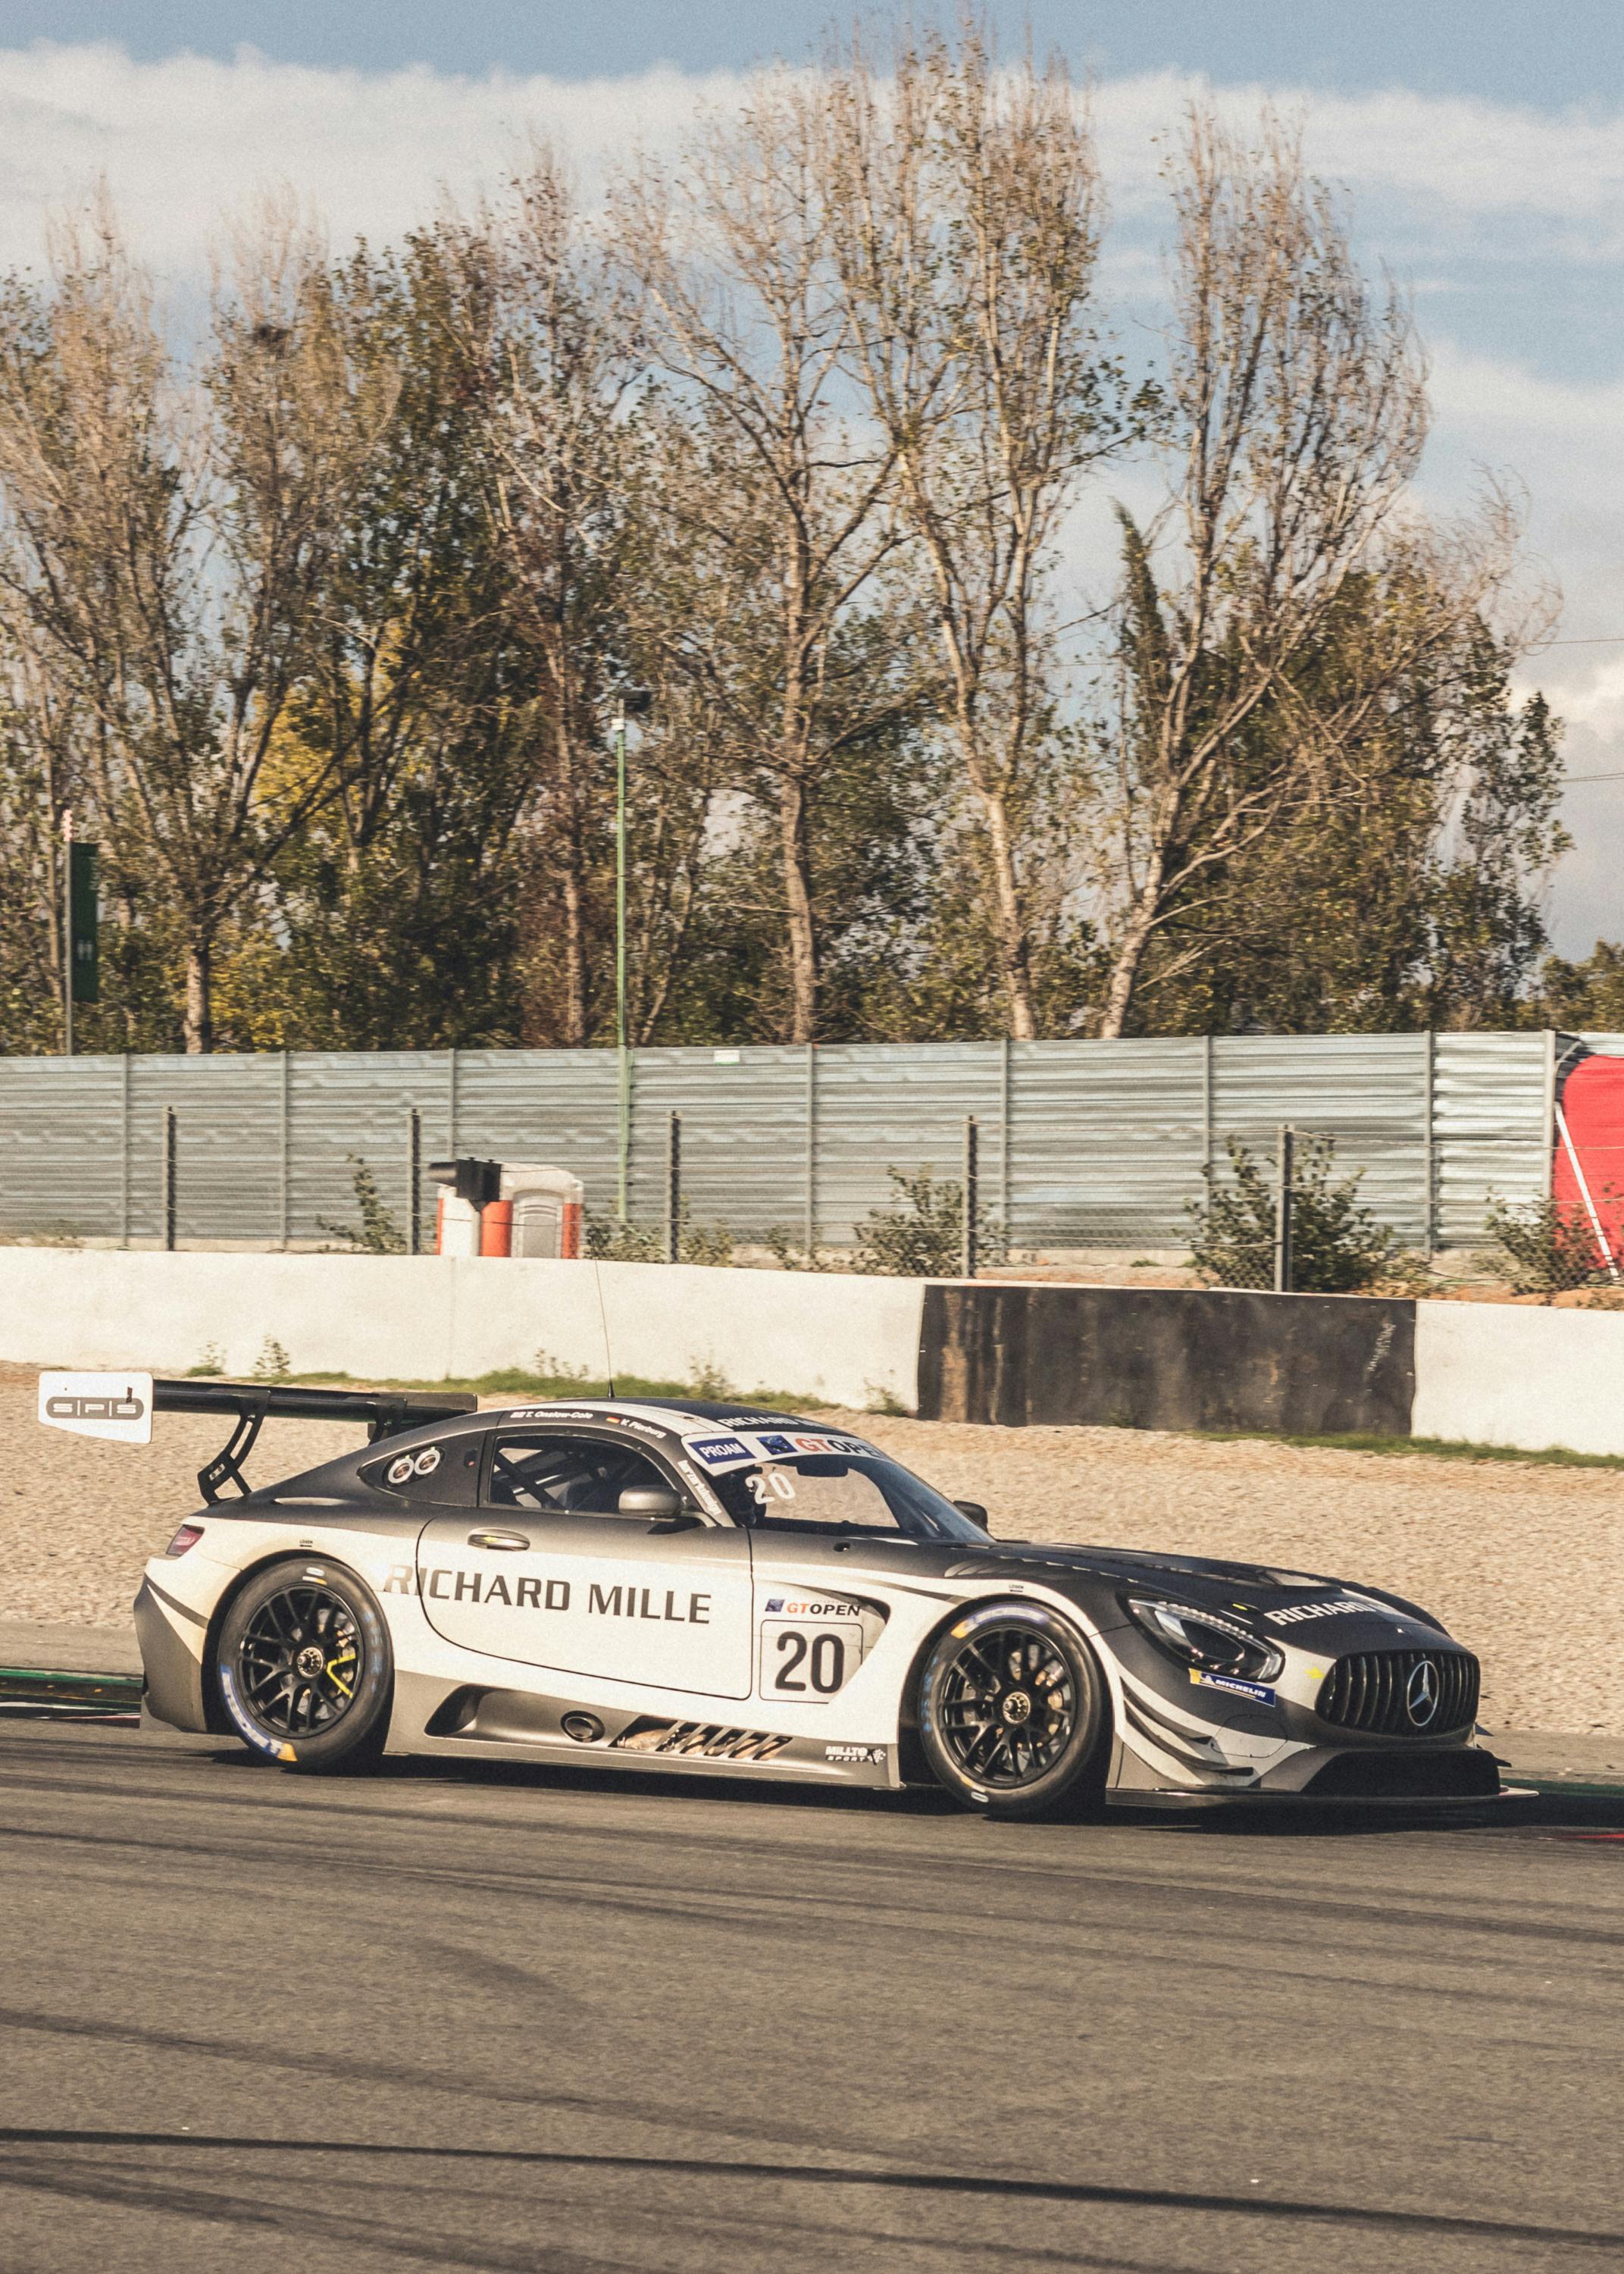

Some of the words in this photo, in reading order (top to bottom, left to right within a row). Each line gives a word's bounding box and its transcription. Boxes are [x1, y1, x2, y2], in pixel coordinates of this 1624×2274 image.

[718, 1417, 799, 1427] RICHARD
[699, 1442, 746, 1458] PROAM
[745, 1473, 796, 1505] 20
[383, 1563, 571, 1611] RICHARD
[588, 1583, 712, 1624] MILLE
[1263, 1601, 1377, 1626] RICHARD
[774, 1631, 845, 1693] 20
[1215, 1679, 1267, 1698] MICHELIN
